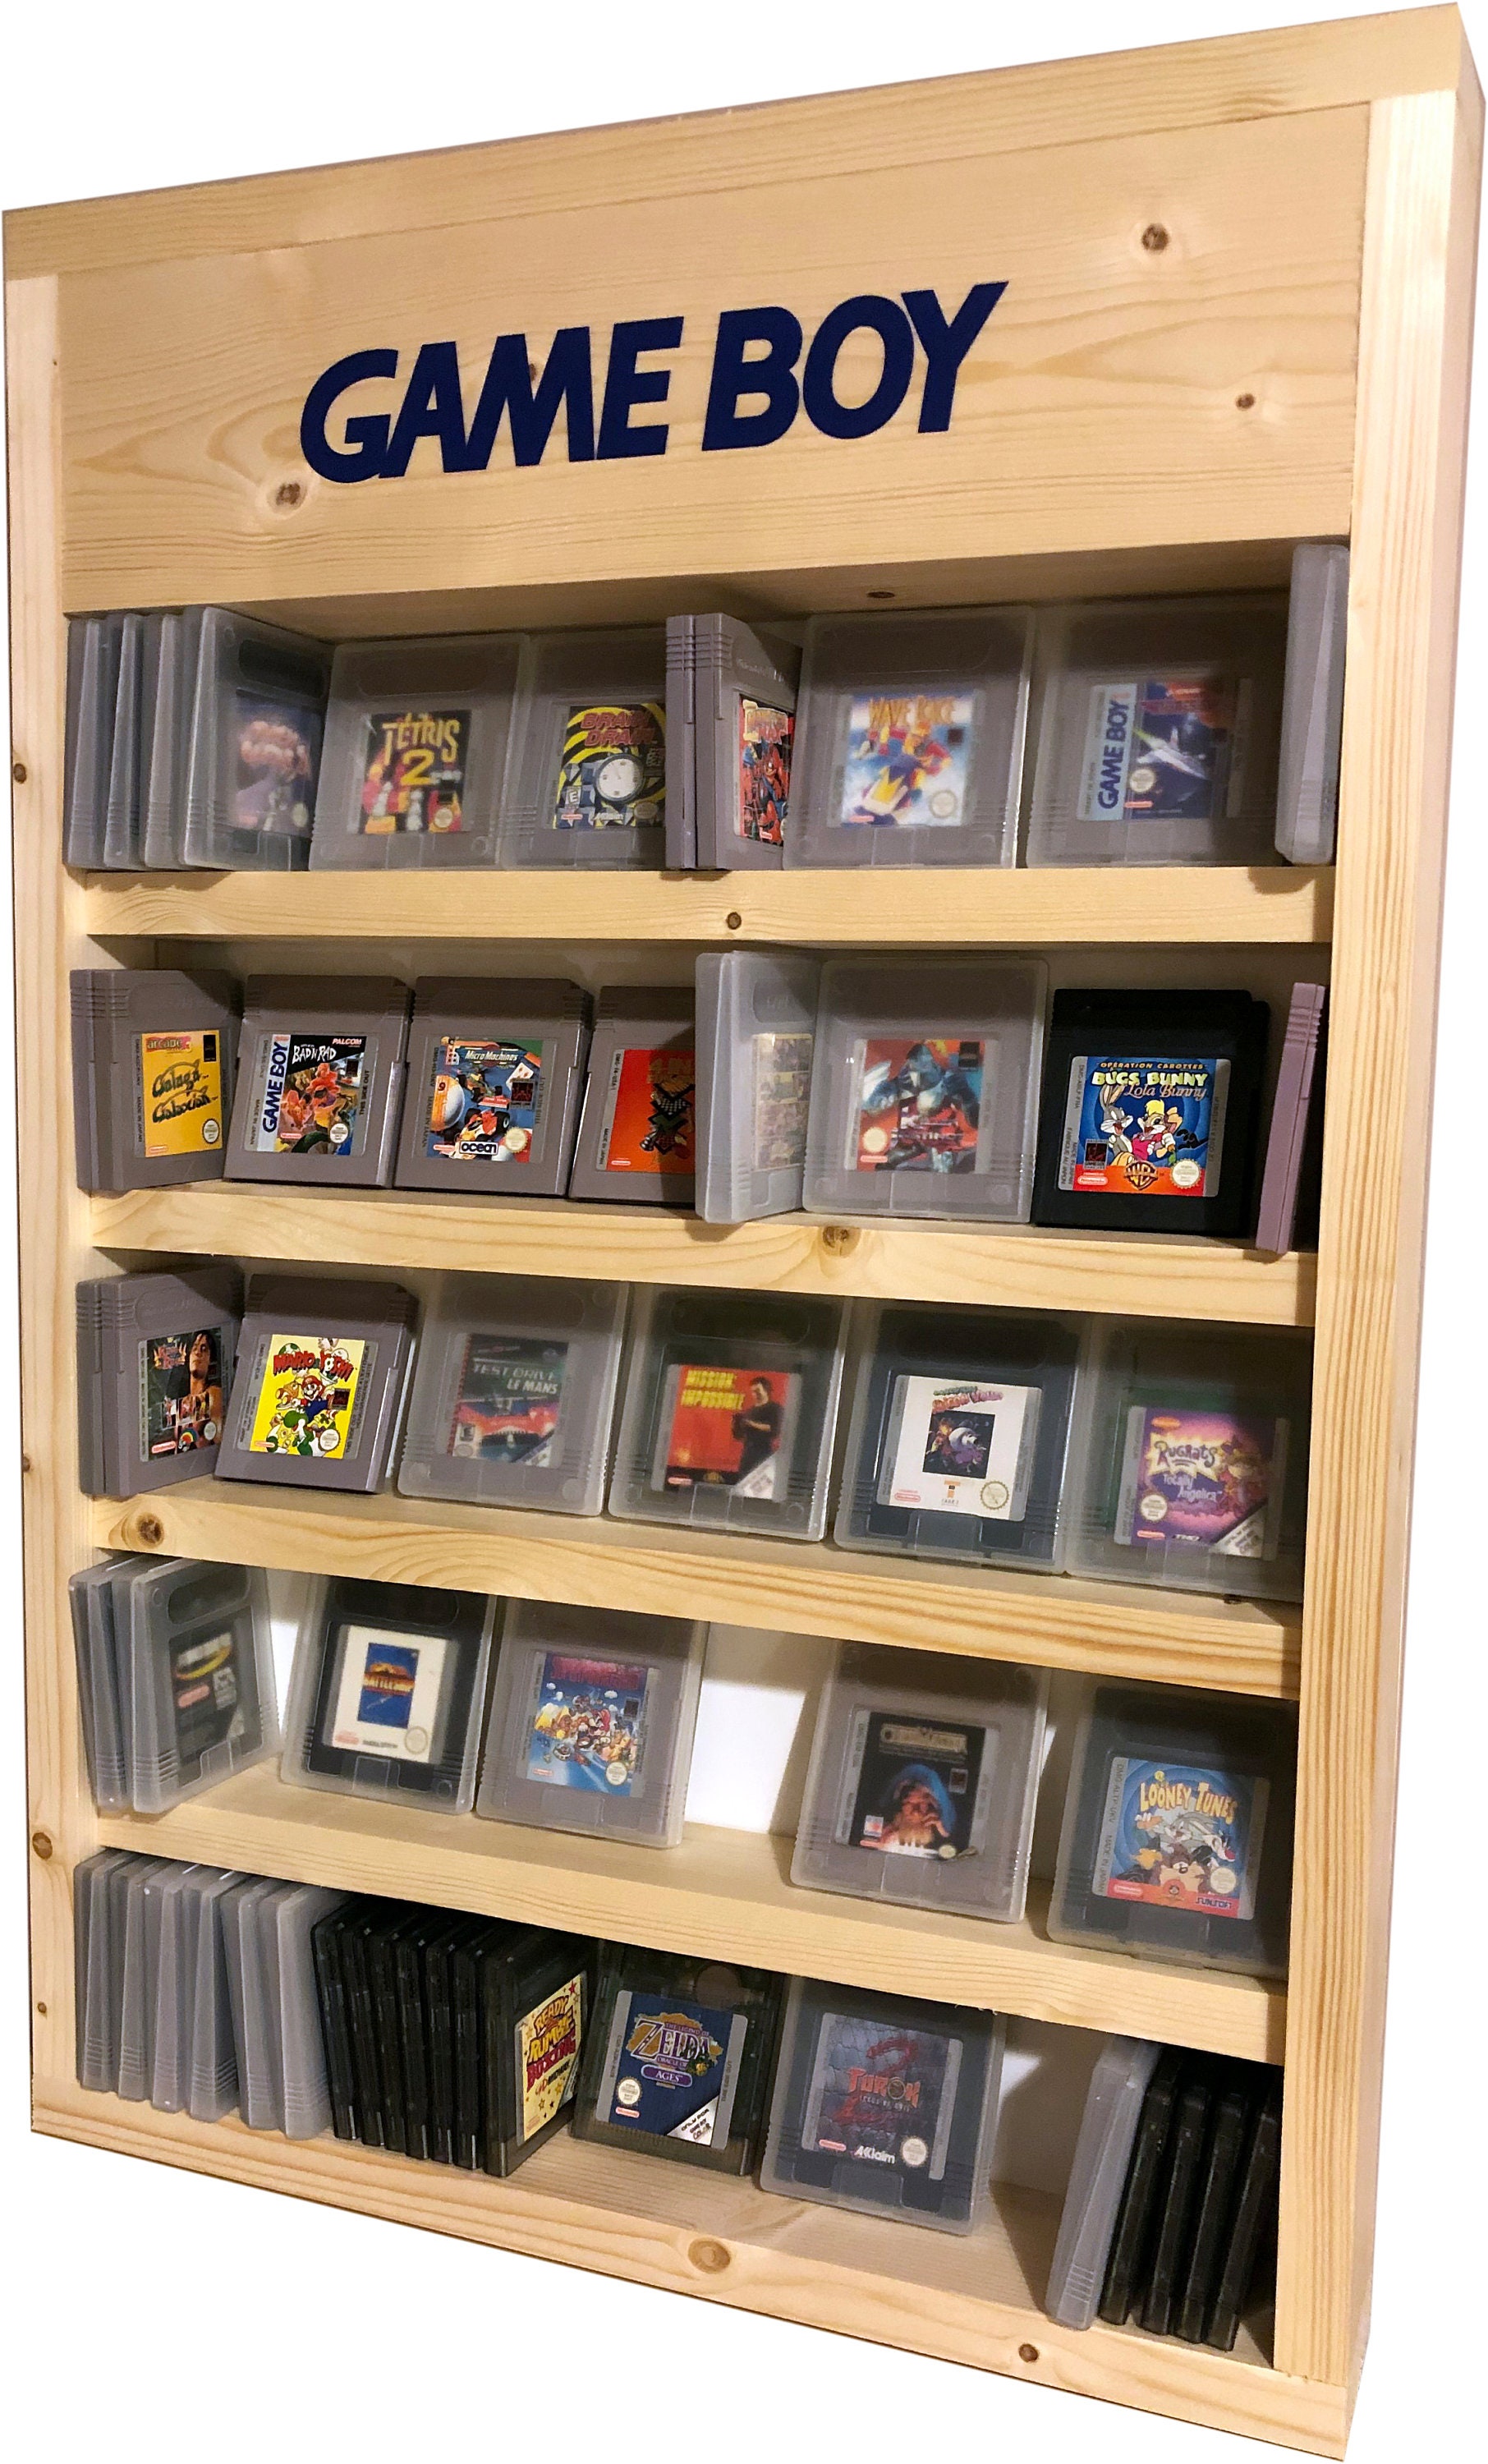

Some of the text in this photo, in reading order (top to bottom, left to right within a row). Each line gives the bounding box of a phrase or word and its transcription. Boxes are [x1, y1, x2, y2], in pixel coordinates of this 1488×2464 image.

[301, 282, 1009, 483] GAME BOY
[382, 716, 461, 765] TETRIS
[1098, 701, 1128, 808] GAME BOY
[400, 748, 435, 786] 2
[270, 1042, 288, 1078] BOY
[465, 1050, 485, 1060] Micro
[358, 1069, 370, 1115] THIS SIDE OUT
[1091, 1071, 1208, 1087] BUGS BUNNY
[1123, 1084, 1207, 1101] Lola Bunny
[263, 1080, 282, 1133] GAME
[462, 1142, 497, 1153] ocean
[273, 1350, 315, 1376] MARIO
[319, 1349, 354, 1381] YOSHI
[473, 1364, 507, 1376] TEST
[507, 1378, 558, 1395] LE MANS
[1178, 1487, 1217, 1503] Angelica
[363, 1674, 416, 1693] BATTLE
[1140, 1781, 1238, 1825] LOONEY TUNES
[1195, 1897, 1232, 1910] SUNSOFT
[535, 1995, 569, 2036] READY
[527, 2007, 576, 2066] RUMBLE
[631, 2018, 710, 2060] ZELDA
[526, 2032, 576, 2093] BOXING
[655, 2071, 680, 2082] AGES
[658, 2057, 679, 2066] ORACLE
[847, 2067, 921, 2108] TUROK
[682, 2117, 696, 2131] ONLY
